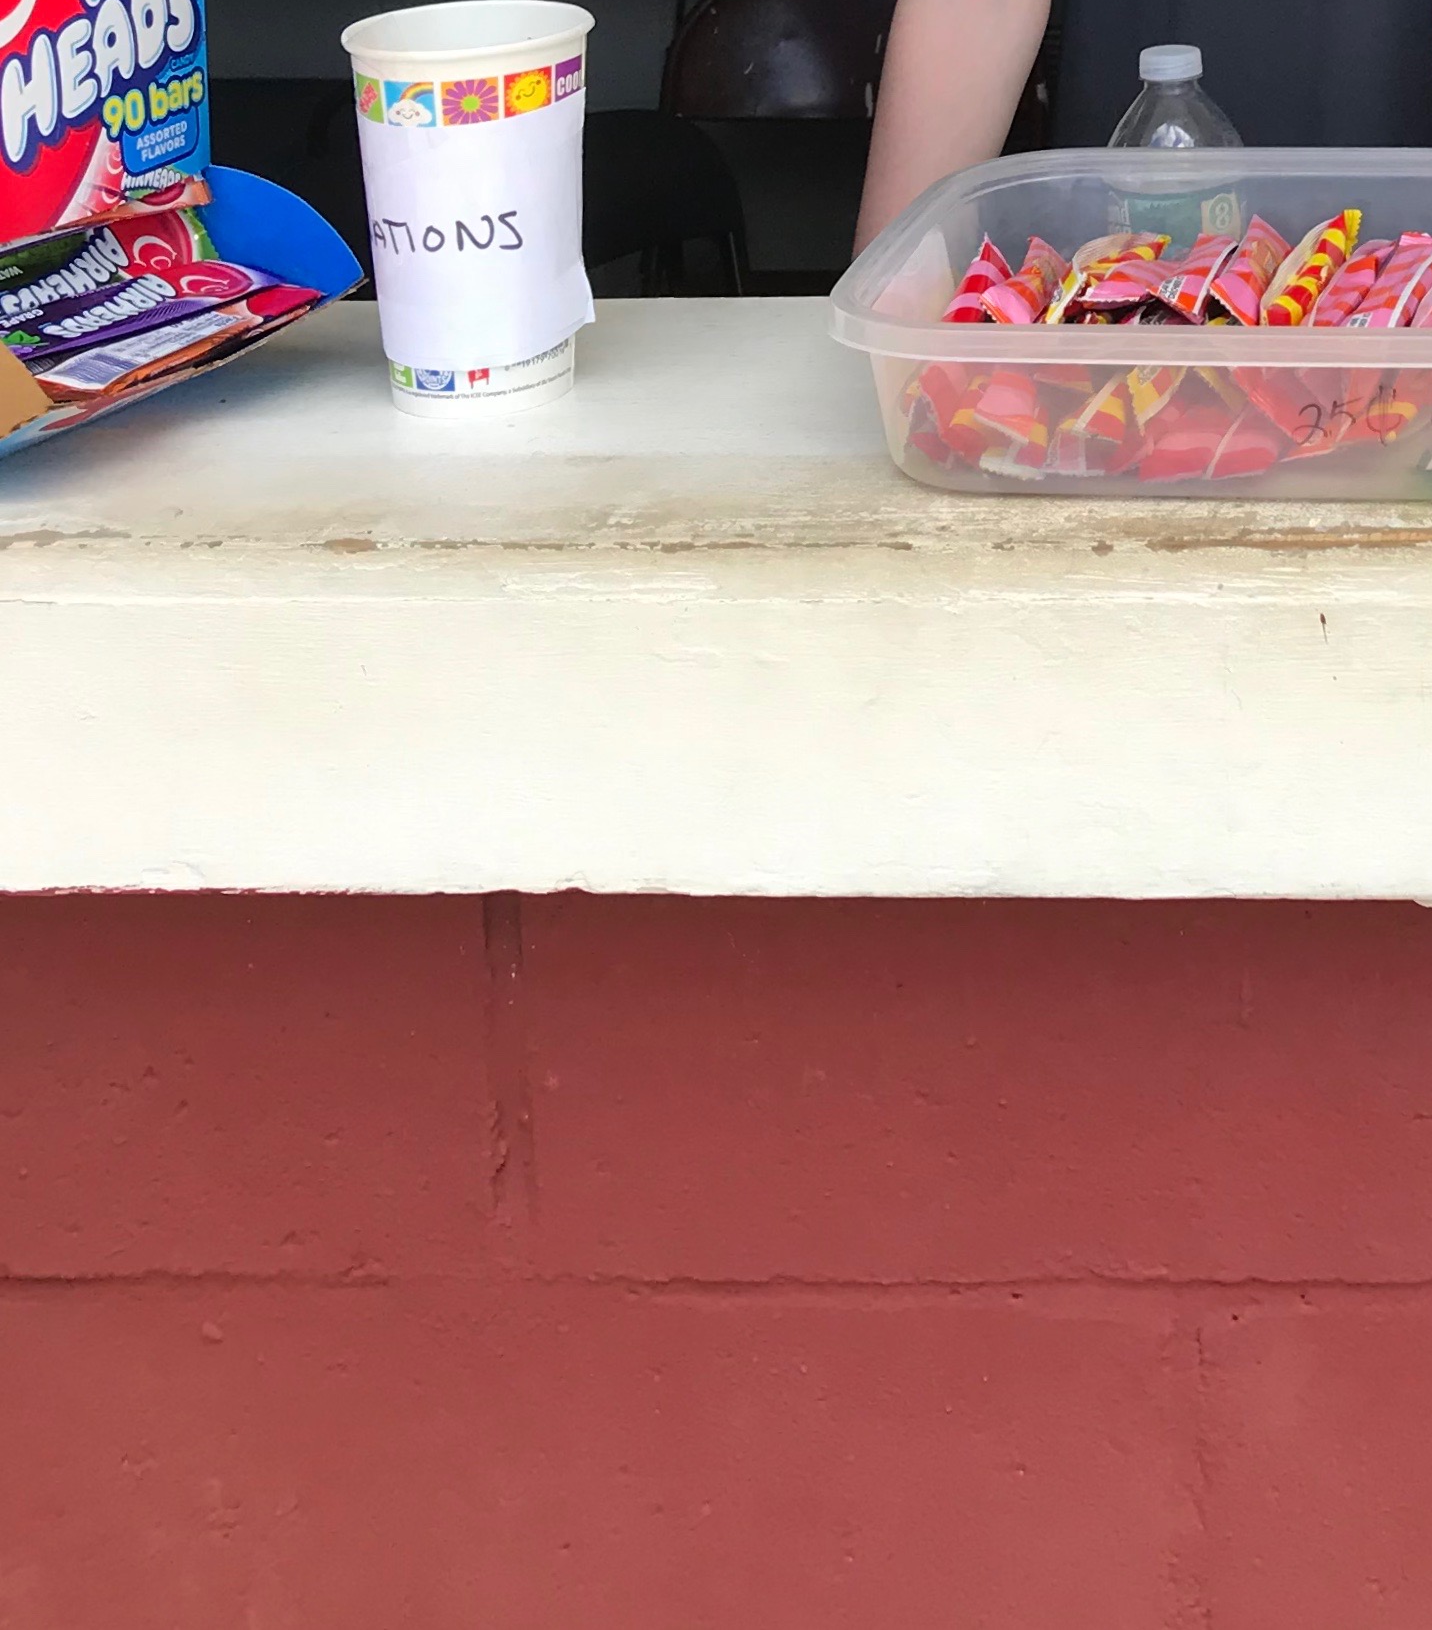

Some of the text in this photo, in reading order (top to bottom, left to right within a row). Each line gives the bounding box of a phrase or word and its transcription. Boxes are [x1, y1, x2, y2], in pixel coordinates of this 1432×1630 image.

[102, 71, 204, 137] 90 bars
[136, 121, 188, 150] ASSORTED
[141, 137, 186, 162] FLAVORS
[1, 227, 129, 314] AIRHEADS
[43, 274, 176, 338] AIRHEADS
